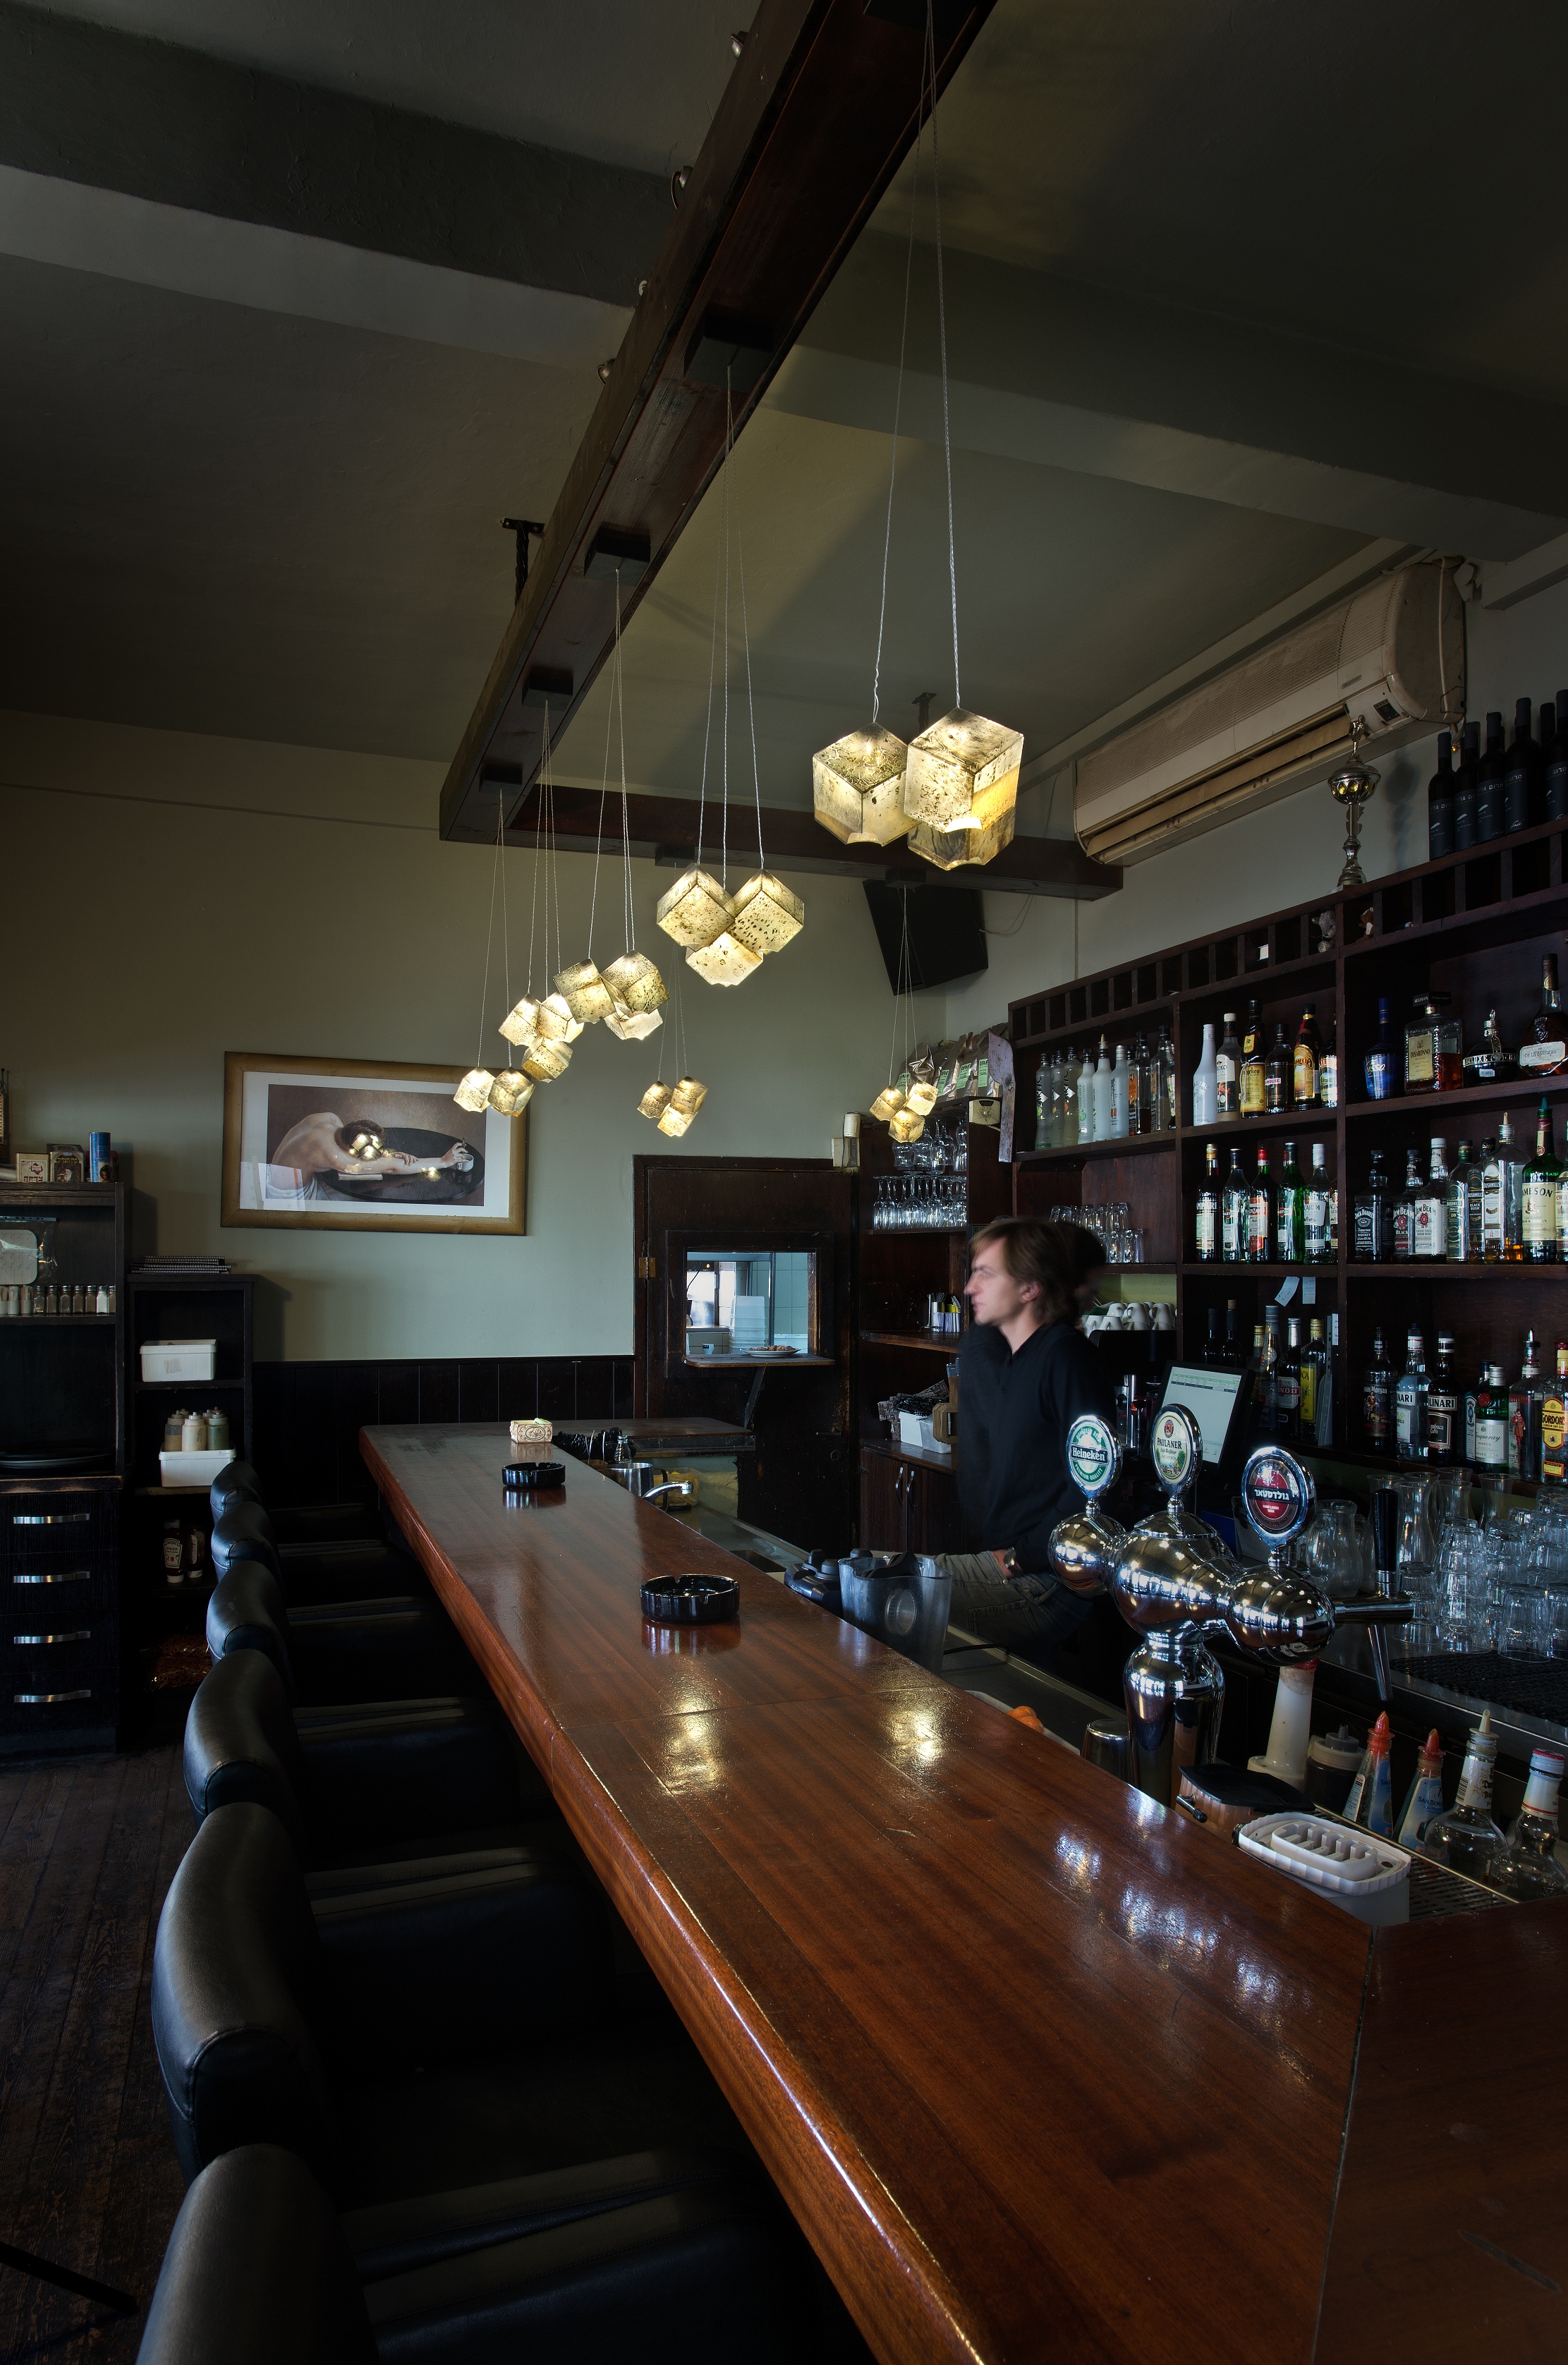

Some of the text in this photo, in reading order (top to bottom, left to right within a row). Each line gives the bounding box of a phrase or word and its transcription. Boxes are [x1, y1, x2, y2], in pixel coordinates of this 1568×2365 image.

[1411, 1048, 1430, 1058] DISARONNO
[1371, 1386, 1387, 1394] Morgan
[1428, 1399, 1454, 1409] LINARI
[1157, 1437, 1182, 1449] PAULANER
[1072, 1447, 1105, 1461] Heineken
[1075, 1464, 1103, 1481] PREMIUM QUALITY
[1254, 1488, 1289, 1501] גולדסטאר
[1418, 1796, 1429, 1804] SAN
